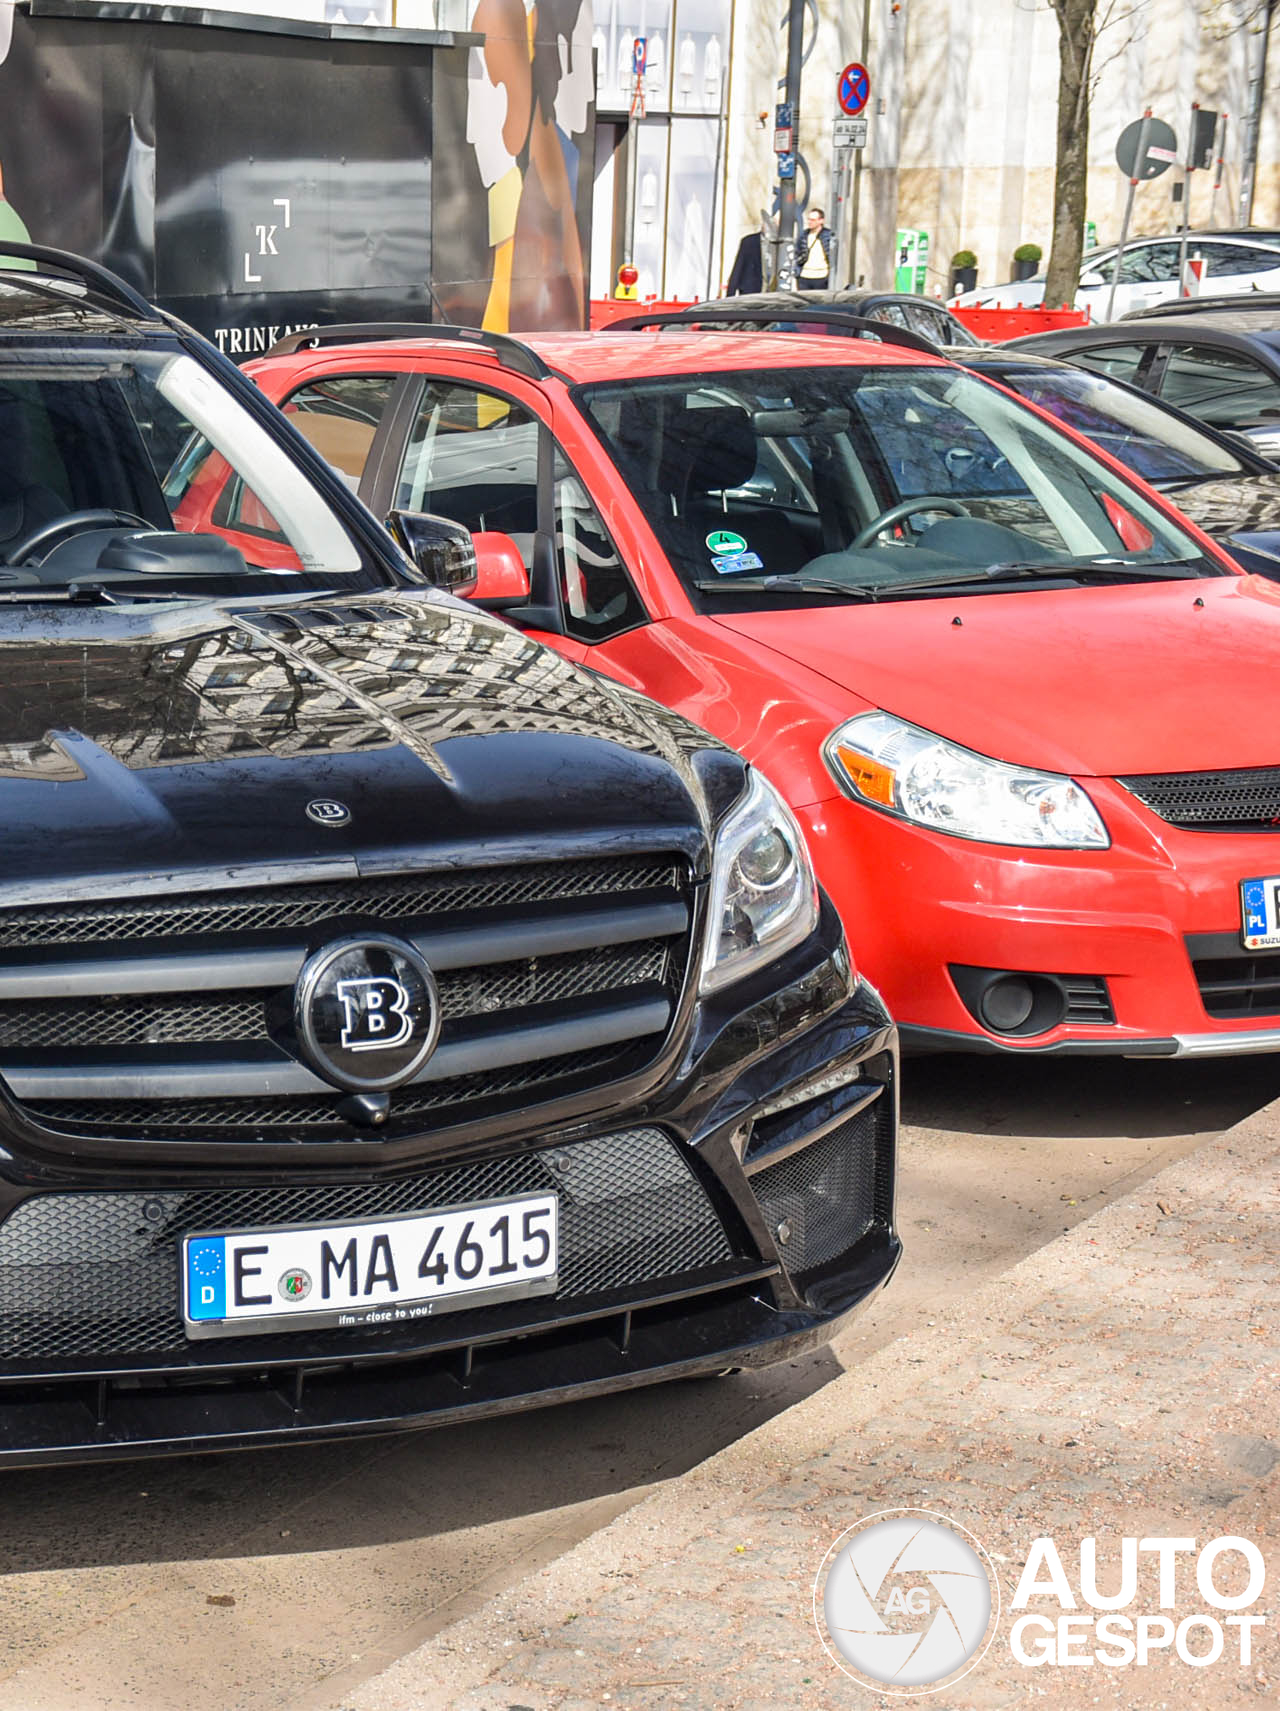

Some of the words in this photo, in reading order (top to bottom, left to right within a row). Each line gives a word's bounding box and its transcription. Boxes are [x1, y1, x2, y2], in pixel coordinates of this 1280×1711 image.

[312, 803, 344, 818] B
[1249, 915, 1265, 928] PL
[337, 978, 413, 1052] B
[232, 1245, 272, 1307] E
[320, 1234, 399, 1299] MA
[417, 1208, 551, 1285] 4615
[201, 1286, 215, 1304] D
[339, 1315, 355, 1325] ifm
[366, 1311, 392, 1323] close
[395, 1309, 406, 1318] to
[409, 1303, 433, 1318] you!
